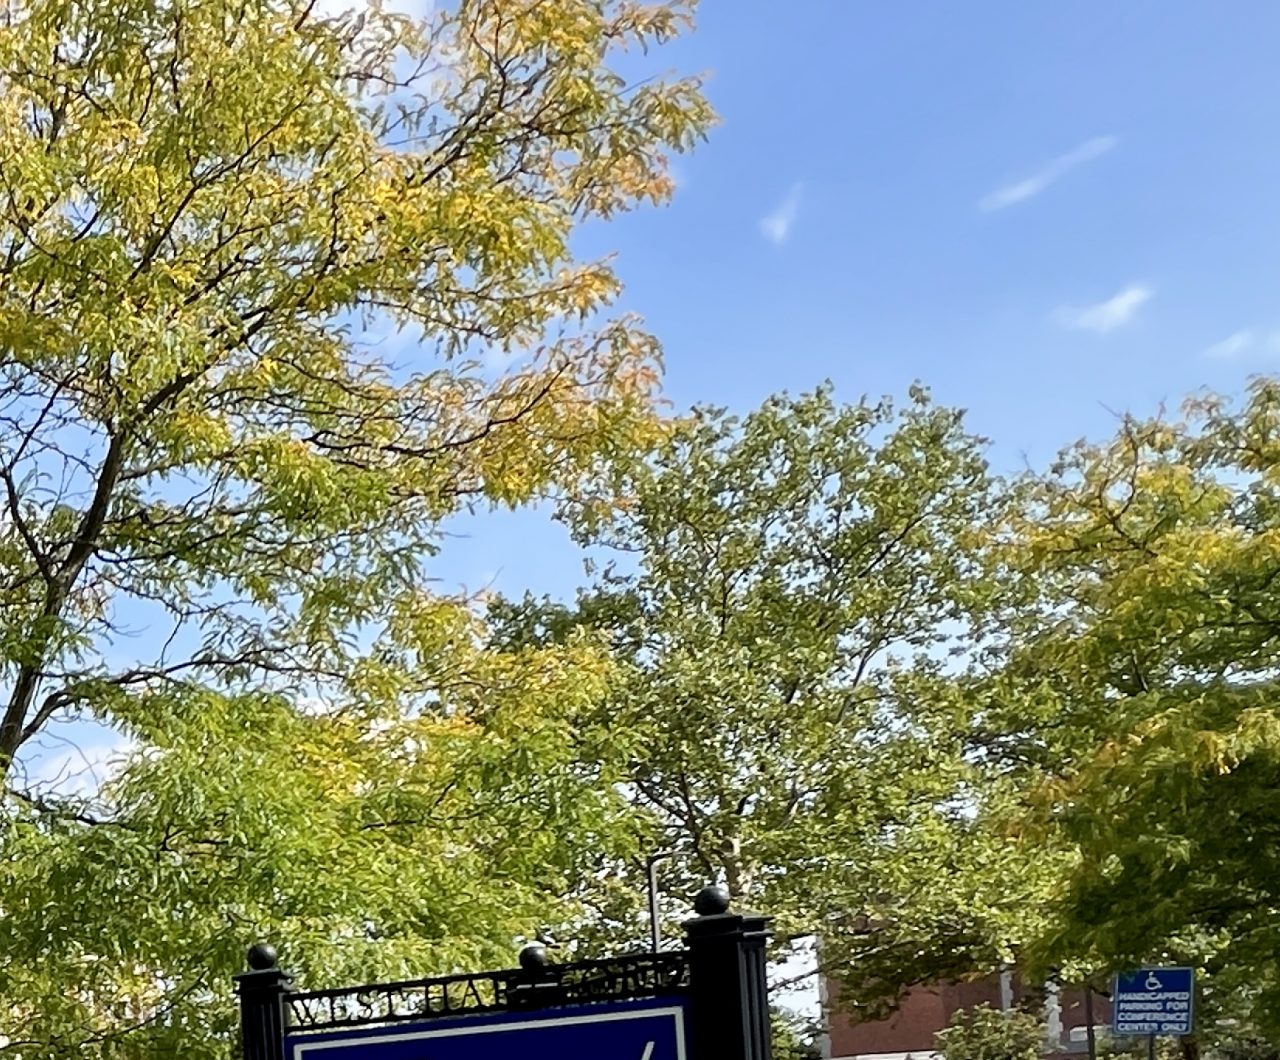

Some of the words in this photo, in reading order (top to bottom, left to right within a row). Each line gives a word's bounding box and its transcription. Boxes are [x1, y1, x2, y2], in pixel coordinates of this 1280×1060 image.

[1119, 992, 1189, 1000] HANDICAPPED
[1120, 1002, 1163, 1010] PARKING
[1166, 1002, 1188, 1010] FOR
[1118, 1012, 1188, 1021] CONFERENCE
[1118, 1022, 1158, 1031] CENTER
[1161, 1022, 1187, 1031] ONLY
